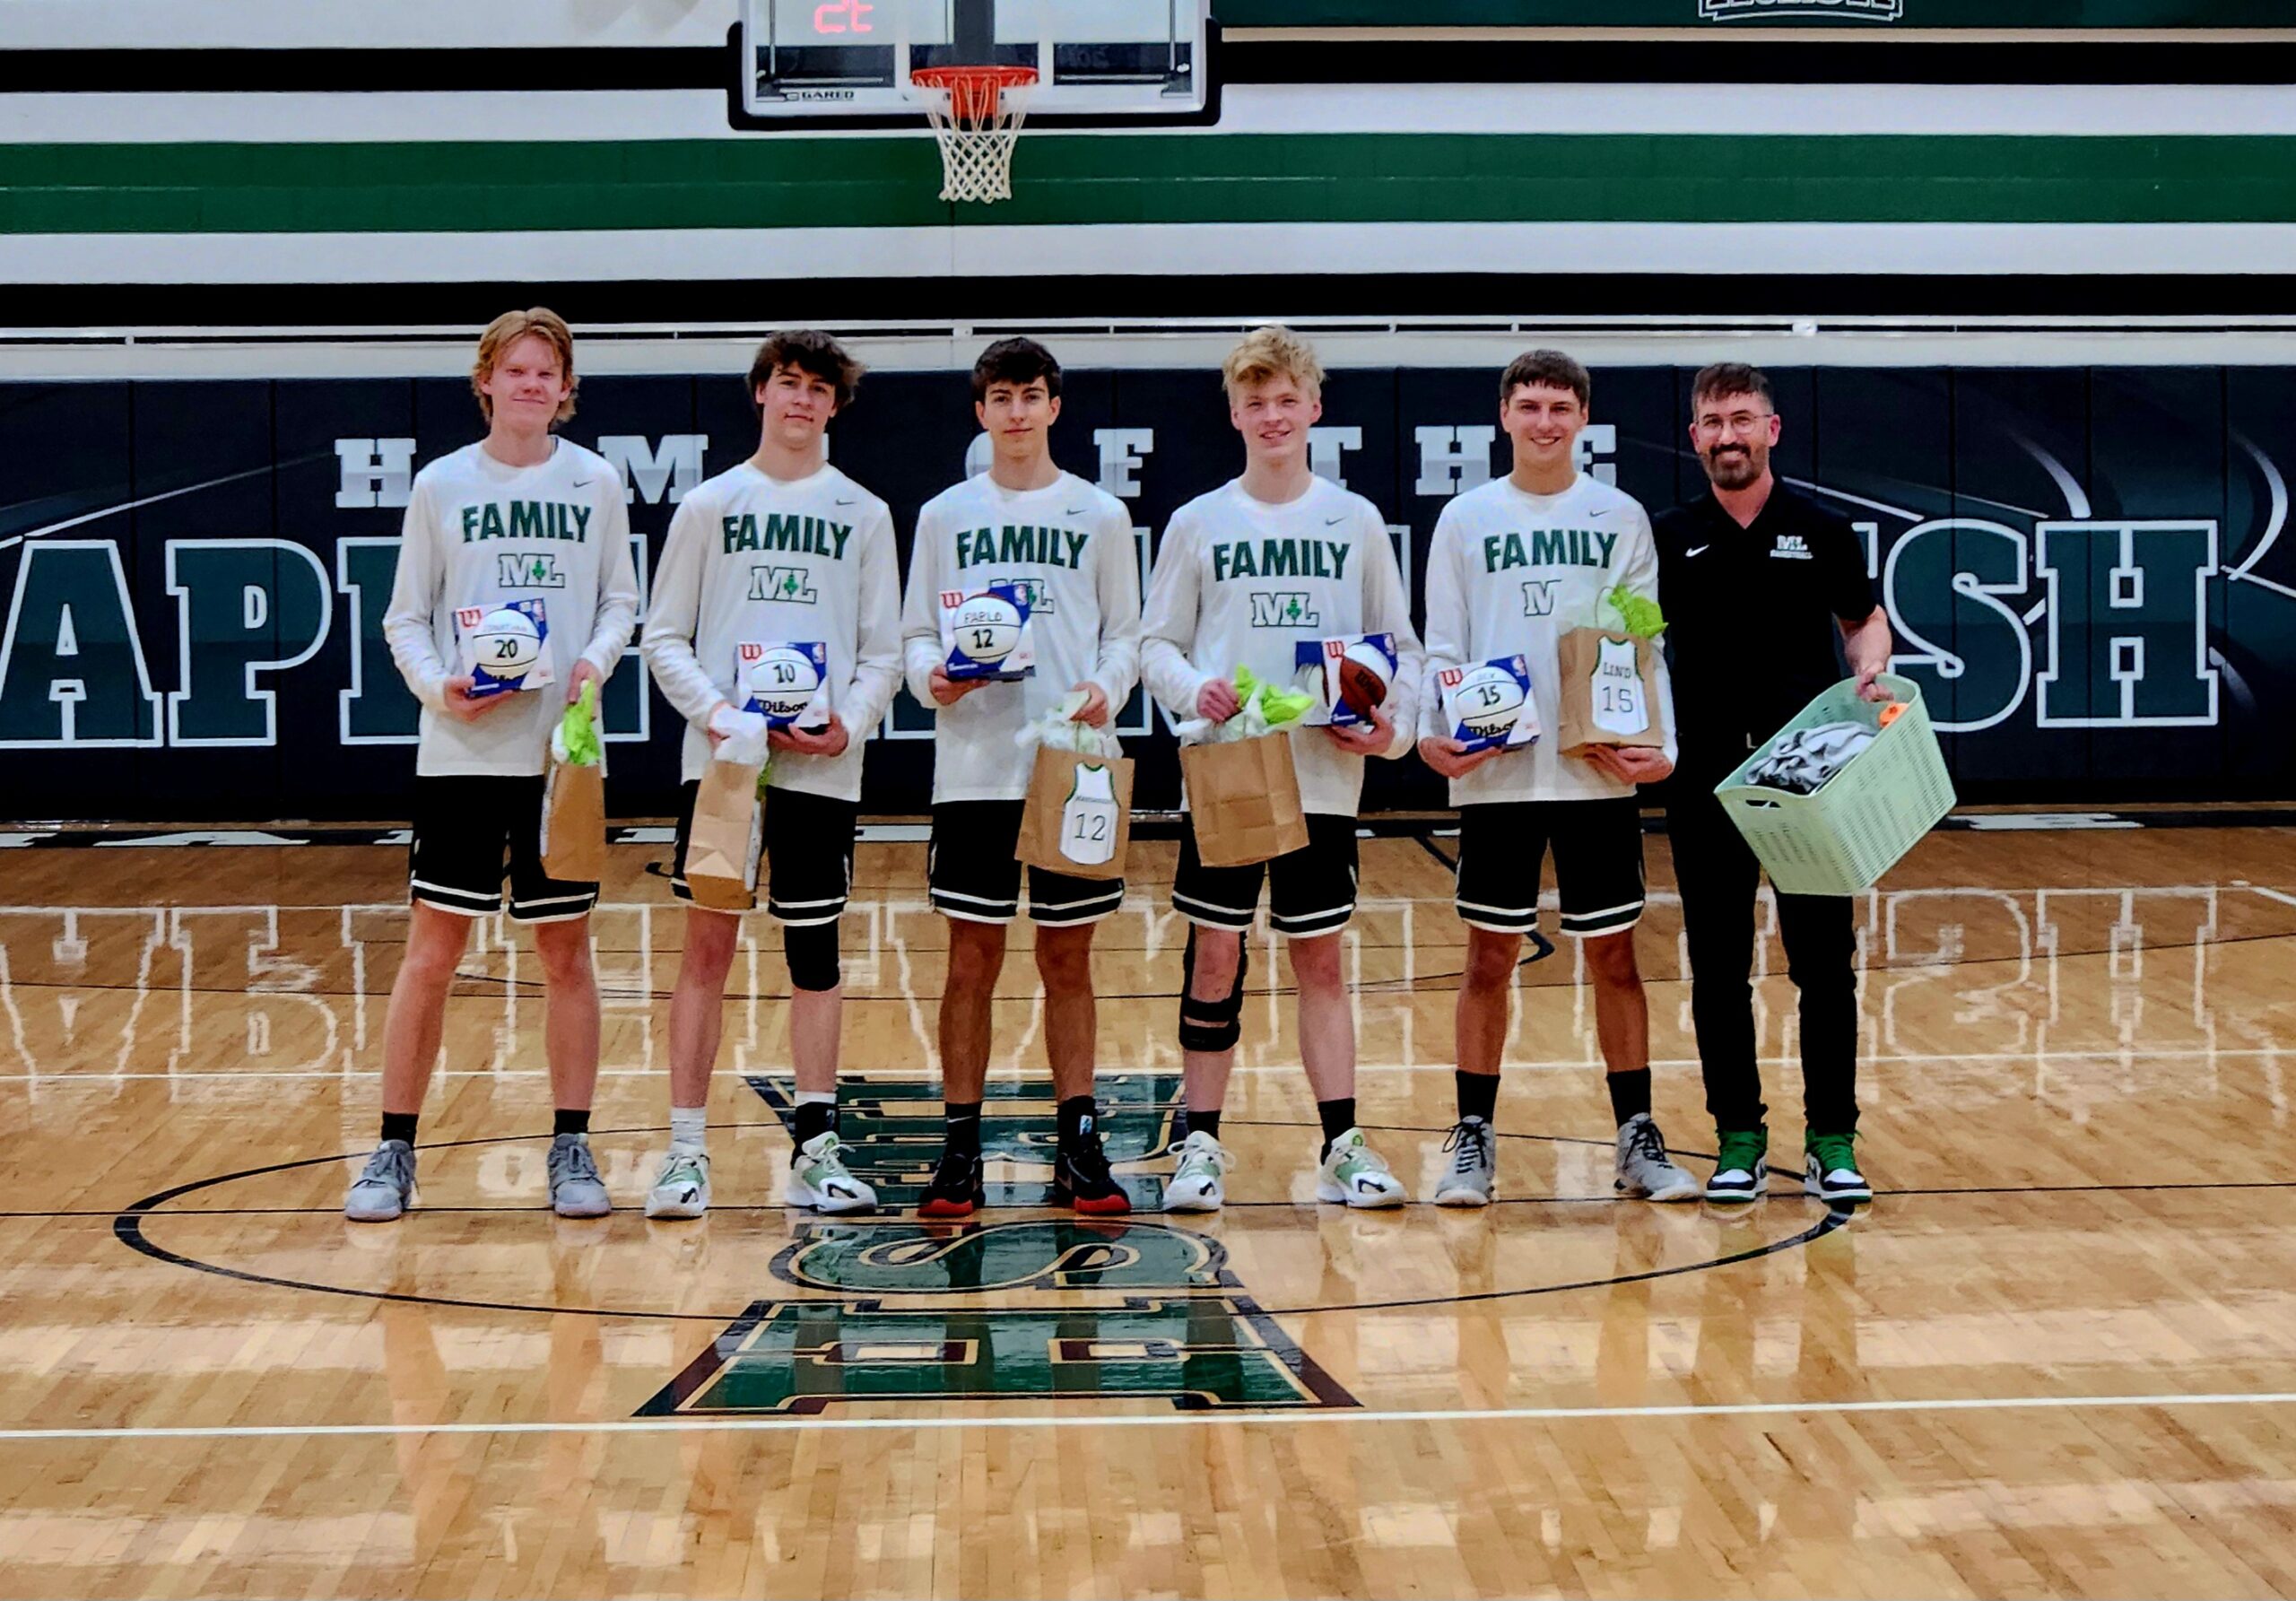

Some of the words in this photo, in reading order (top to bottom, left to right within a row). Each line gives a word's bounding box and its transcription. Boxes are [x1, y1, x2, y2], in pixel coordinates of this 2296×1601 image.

[462, 500, 592, 544] FAMILY
[723, 513, 854, 561] FAMILY
[957, 525, 1090, 570] FAMILY
[1213, 538, 1352, 582] FAMILY
[1484, 529, 1619, 573] FAMILY
[498, 553, 565, 588] ML
[747, 565, 817, 605] ML
[1250, 592, 1320, 628] ML
[494, 639, 518, 659] 20
[971, 629, 994, 649] 12
[772, 663, 796, 683] 10
[1477, 684, 1501, 707] 15
[1602, 685, 1634, 714] 15
[1074, 812, 1107, 841] 12
